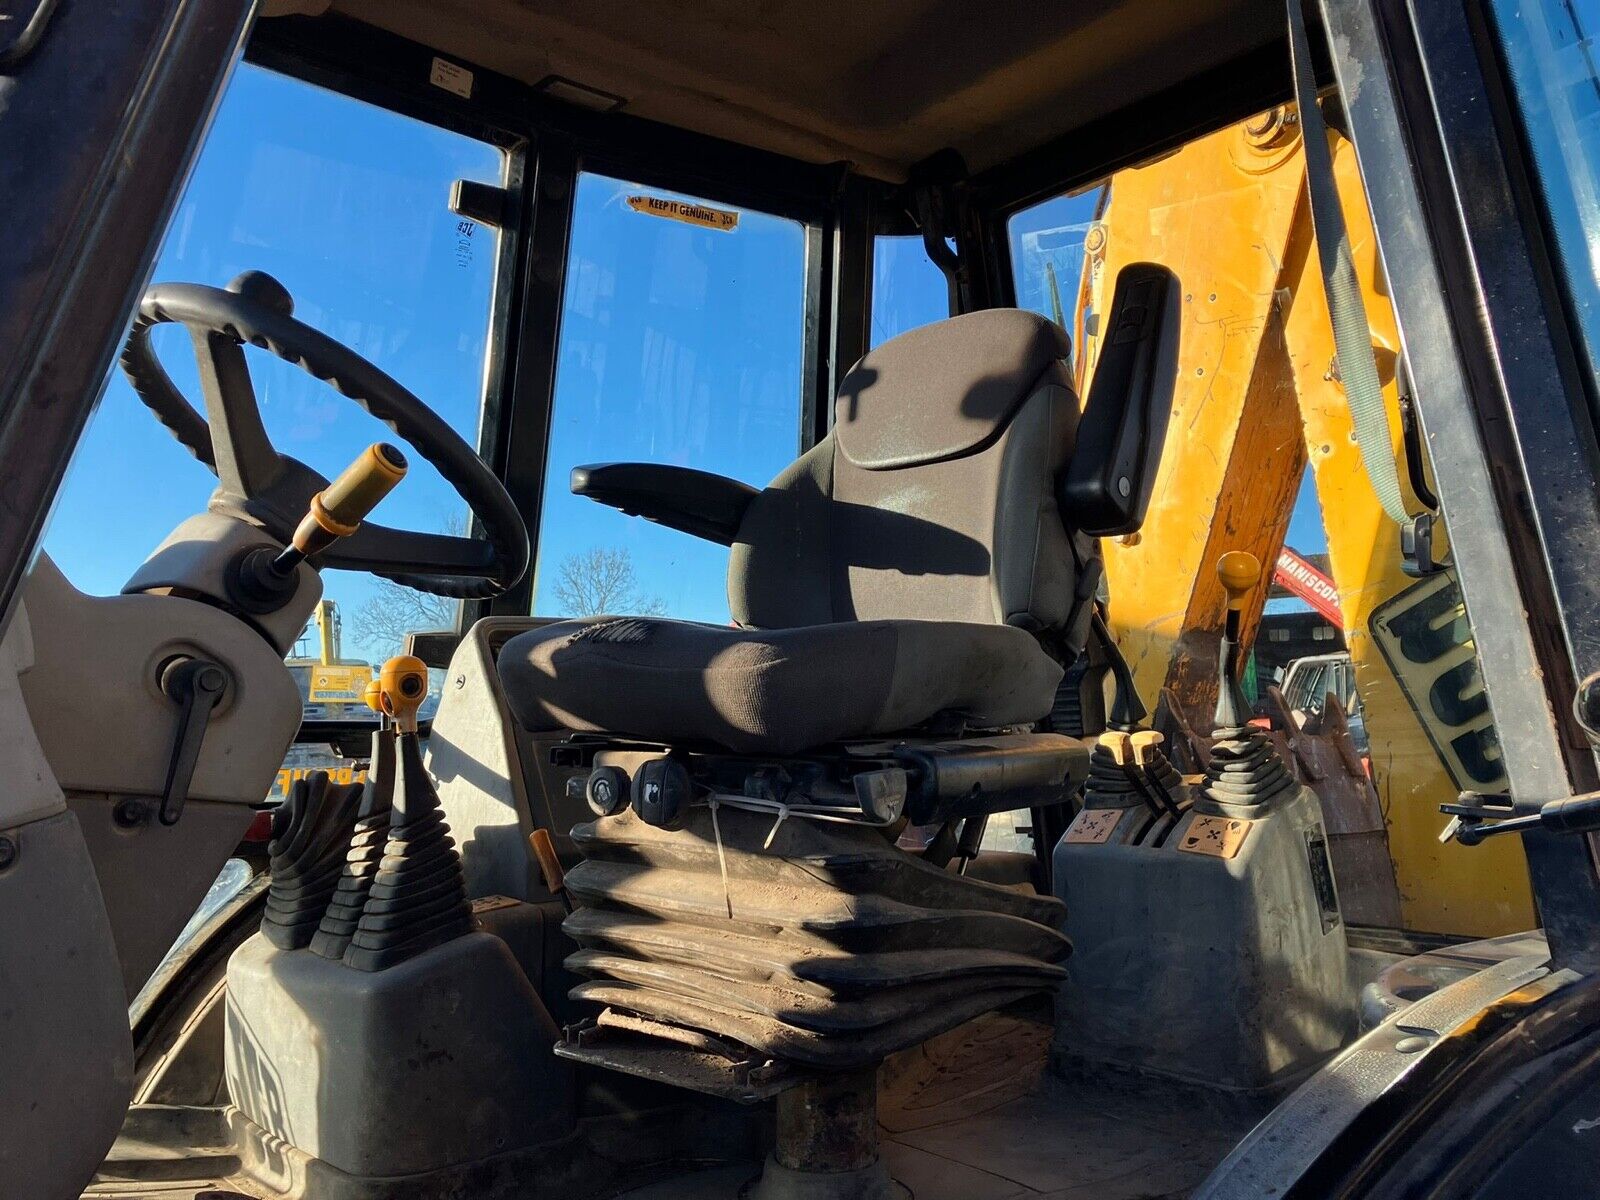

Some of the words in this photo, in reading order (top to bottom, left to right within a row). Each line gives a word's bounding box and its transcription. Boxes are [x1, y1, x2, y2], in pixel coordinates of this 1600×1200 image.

[648, 198, 669, 210] KEEP
[670, 201, 678, 213] IT
[679, 205, 717, 223] GENUINE.
[1277, 553, 1340, 608] MANISCOP
